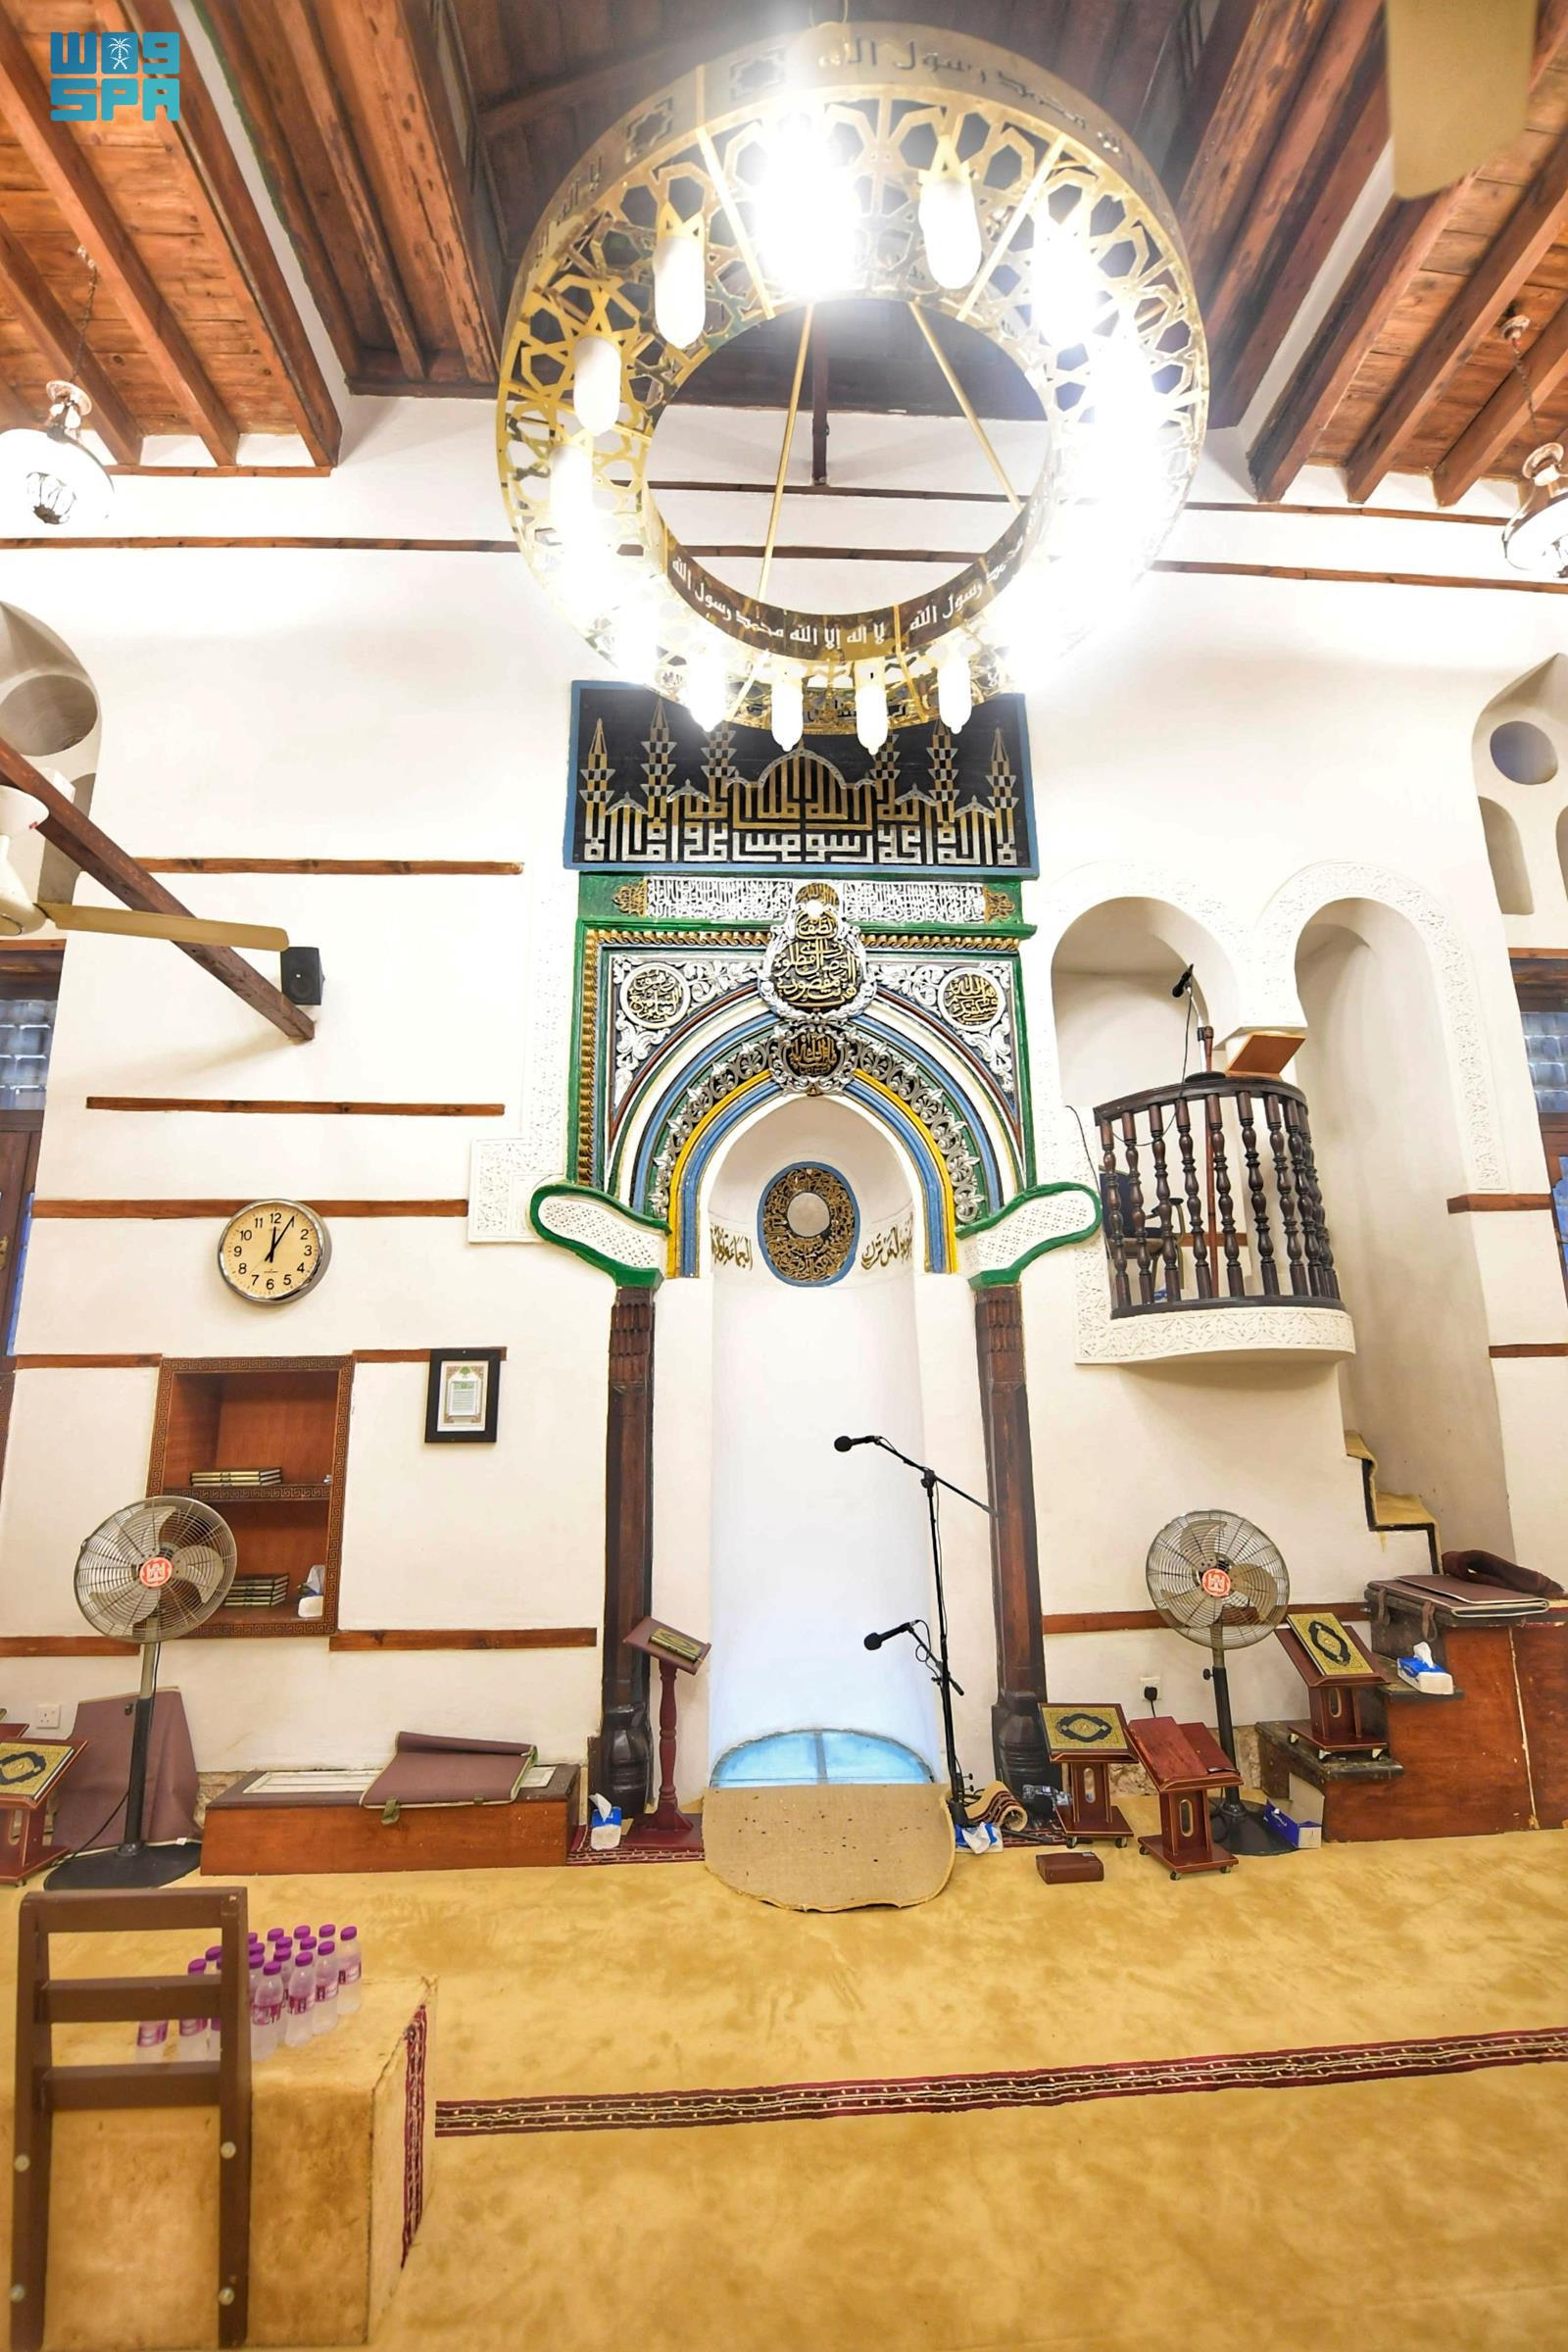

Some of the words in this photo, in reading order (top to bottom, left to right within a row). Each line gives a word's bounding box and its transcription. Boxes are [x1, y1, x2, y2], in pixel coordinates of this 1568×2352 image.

[671, 556, 693, 591] الله
[693, 582, 732, 622] رسول
[942, 581, 984, 619] رسول
[735, 610, 785, 638] محمد
[908, 605, 939, 632] الله
[789, 623, 818, 645] الله
[872, 621, 885, 645] لا
[255, 1218, 263, 1228] 11
[270, 1213, 282, 1224] 12
[240, 1230, 253, 1242] 10
[300, 1229, 309, 1241] 2
[233, 1246, 242, 1257] 9
[304, 1245, 313, 1256] 3
[238, 1263, 247, 1274] 8
[297, 1262, 305, 1273] 4
[251, 1275, 260, 1286] 7
[266, 1279, 274, 1291] 6
[283, 1274, 292, 1286] 5
